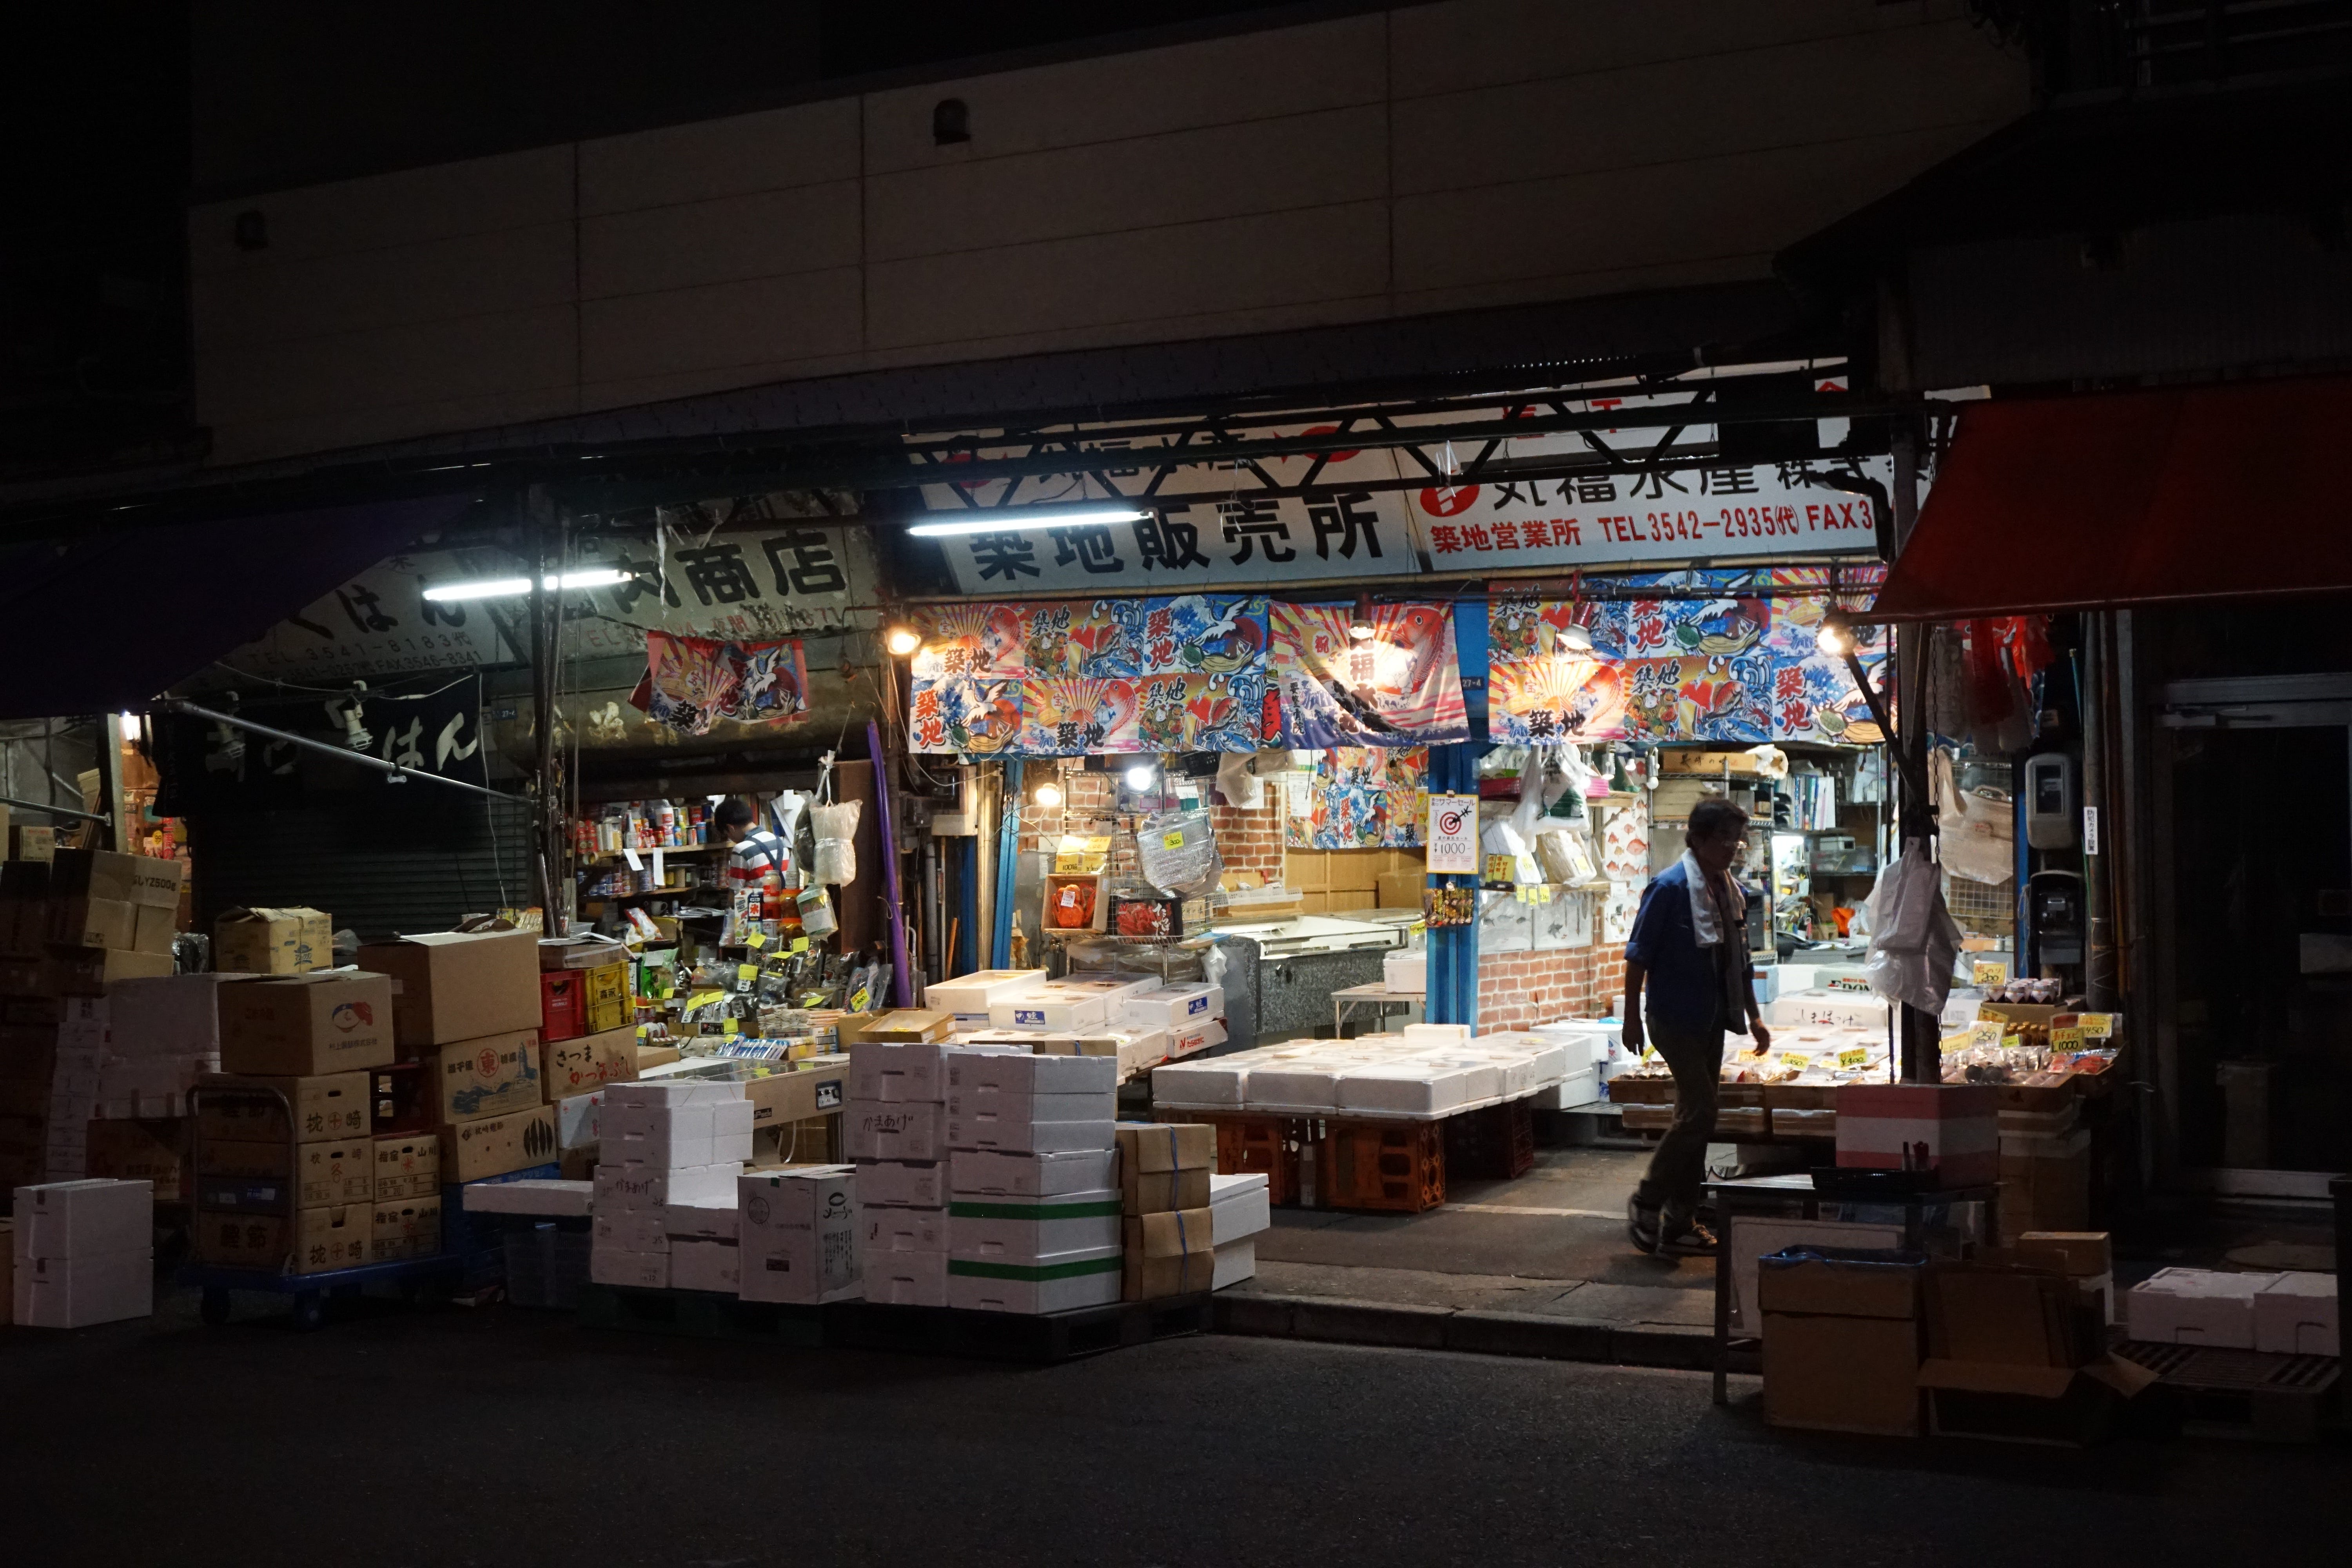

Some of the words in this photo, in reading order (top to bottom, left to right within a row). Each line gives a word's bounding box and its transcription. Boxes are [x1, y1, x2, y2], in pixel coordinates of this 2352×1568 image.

[972, 493, 1382, 581] 築地販売所
[1430, 517, 1582, 554] 築地営業所
[1033, 604, 1070, 634] 築地
[1633, 593, 1666, 652] 築地
[1146, 608, 1177, 669] 築地
[944, 647, 992, 674] 築地
[1632, 659, 1682, 691] 築地
[1147, 676, 1187, 707] 築地
[1462, 678, 1481, 688] 27-4
[1775, 666, 1812, 733] 築地
[915, 688, 945, 749] 築地
[1529, 710, 1586, 738] 築地
[1056, 721, 1105, 748] 築地
[1439, 798, 1475, 806] サマーセール
[1340, 797, 1353, 843] 築地
[557, 1044, 592, 1067] さつま
[570, 1060, 631, 1085] かつおぶし
[863, 1114, 914, 1131] かまあげ
[417, 1144, 437, 1158] 山川
